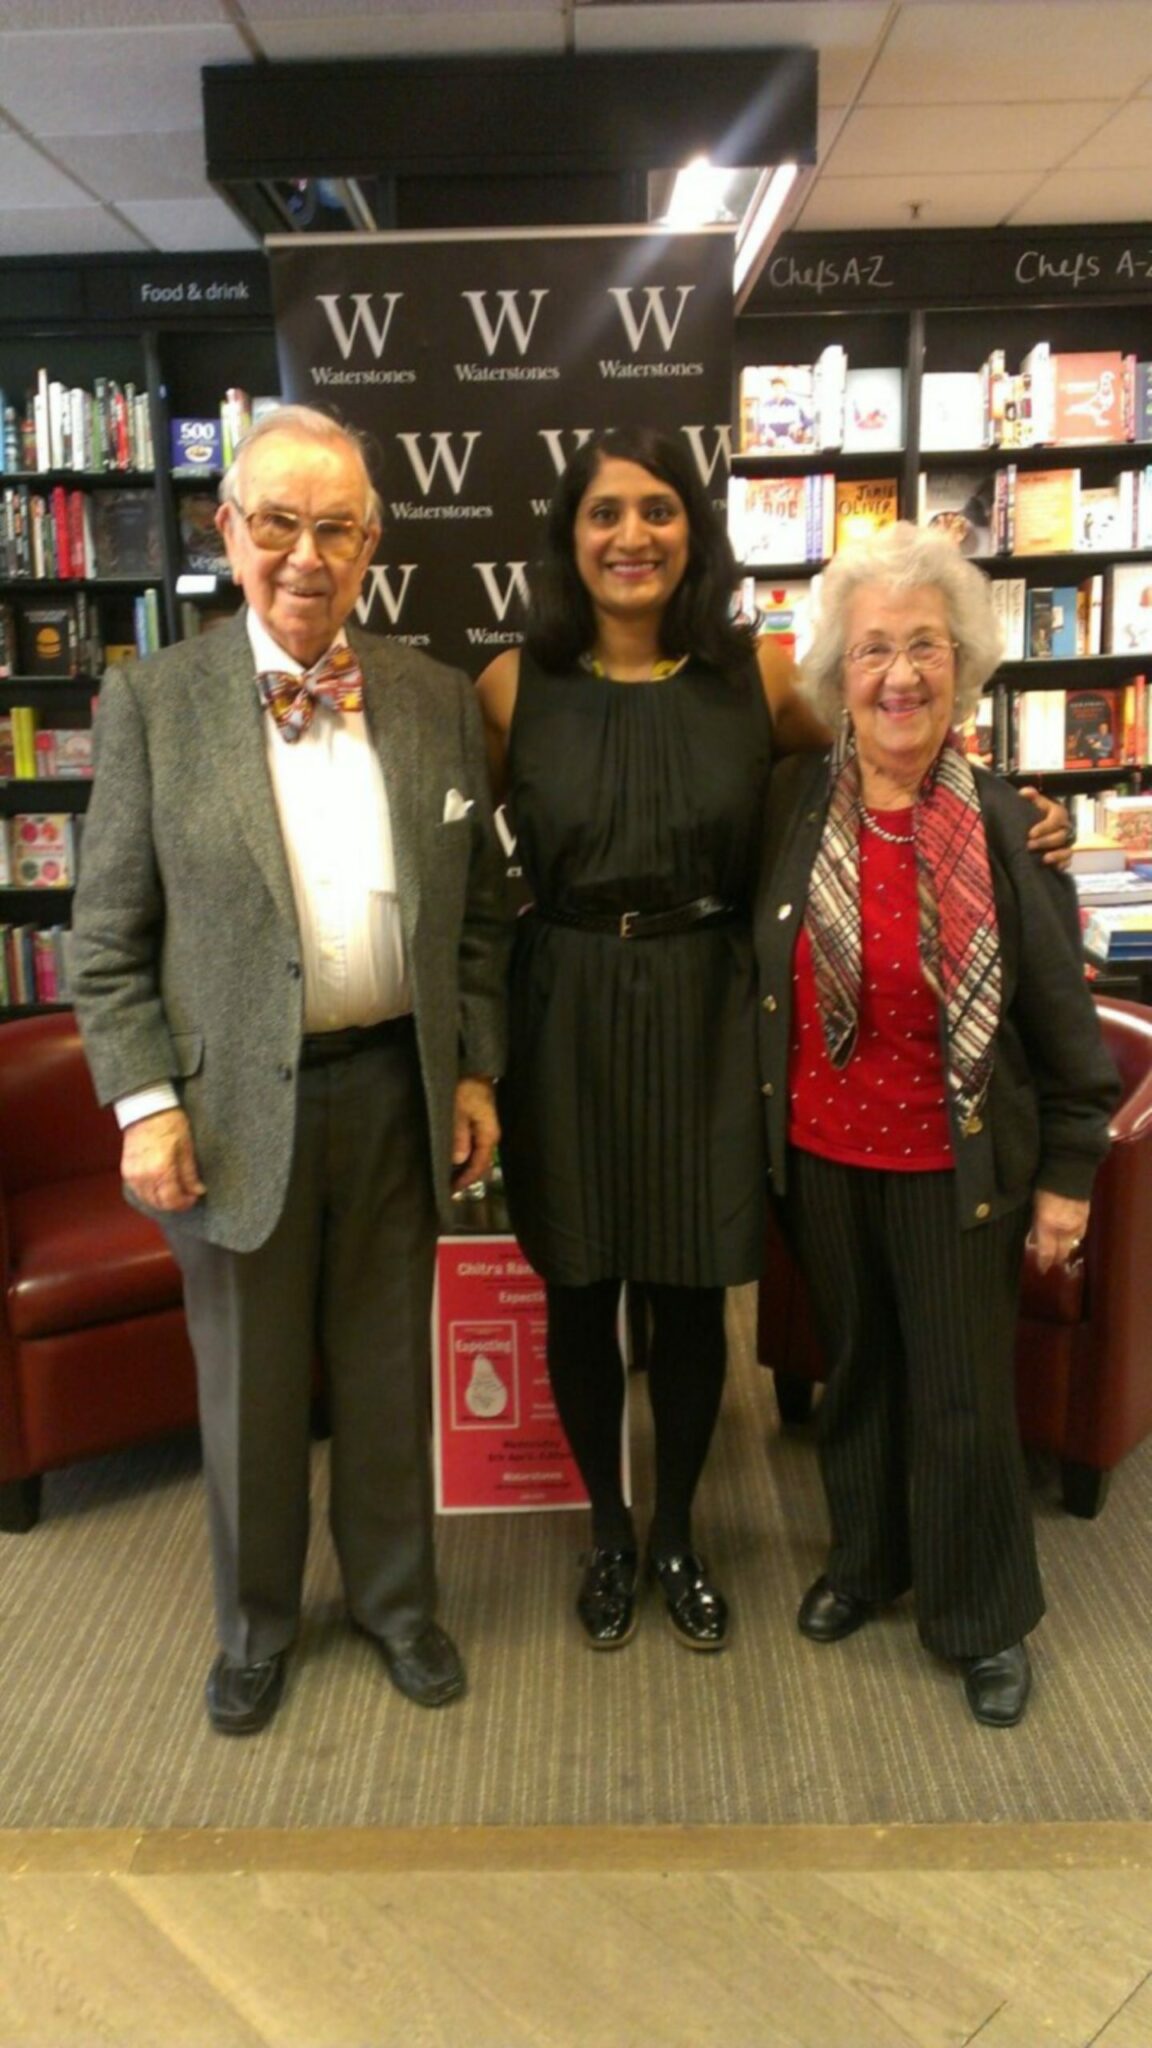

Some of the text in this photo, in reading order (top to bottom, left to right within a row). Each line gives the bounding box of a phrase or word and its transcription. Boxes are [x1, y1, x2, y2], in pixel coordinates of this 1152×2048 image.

[769, 255, 894, 293] Chefs A-Z
[1015, 249, 1152, 287] Chefs A-
[141, 282, 249, 301] Food & drink
[316, 292, 404, 360] W
[461, 289, 549, 357] W
[608, 285, 696, 353] W
[311, 366, 417, 385] Waterstones
[455, 363, 560, 382] Waterstones
[599, 360, 704, 378] Waterstones
[180, 421, 216, 440] 500
[396, 431, 483, 495] W
[390, 502, 493, 519] Waterstones
[466, 628, 524, 645] Waters
[457, 1261, 504, 1276] Chitra
